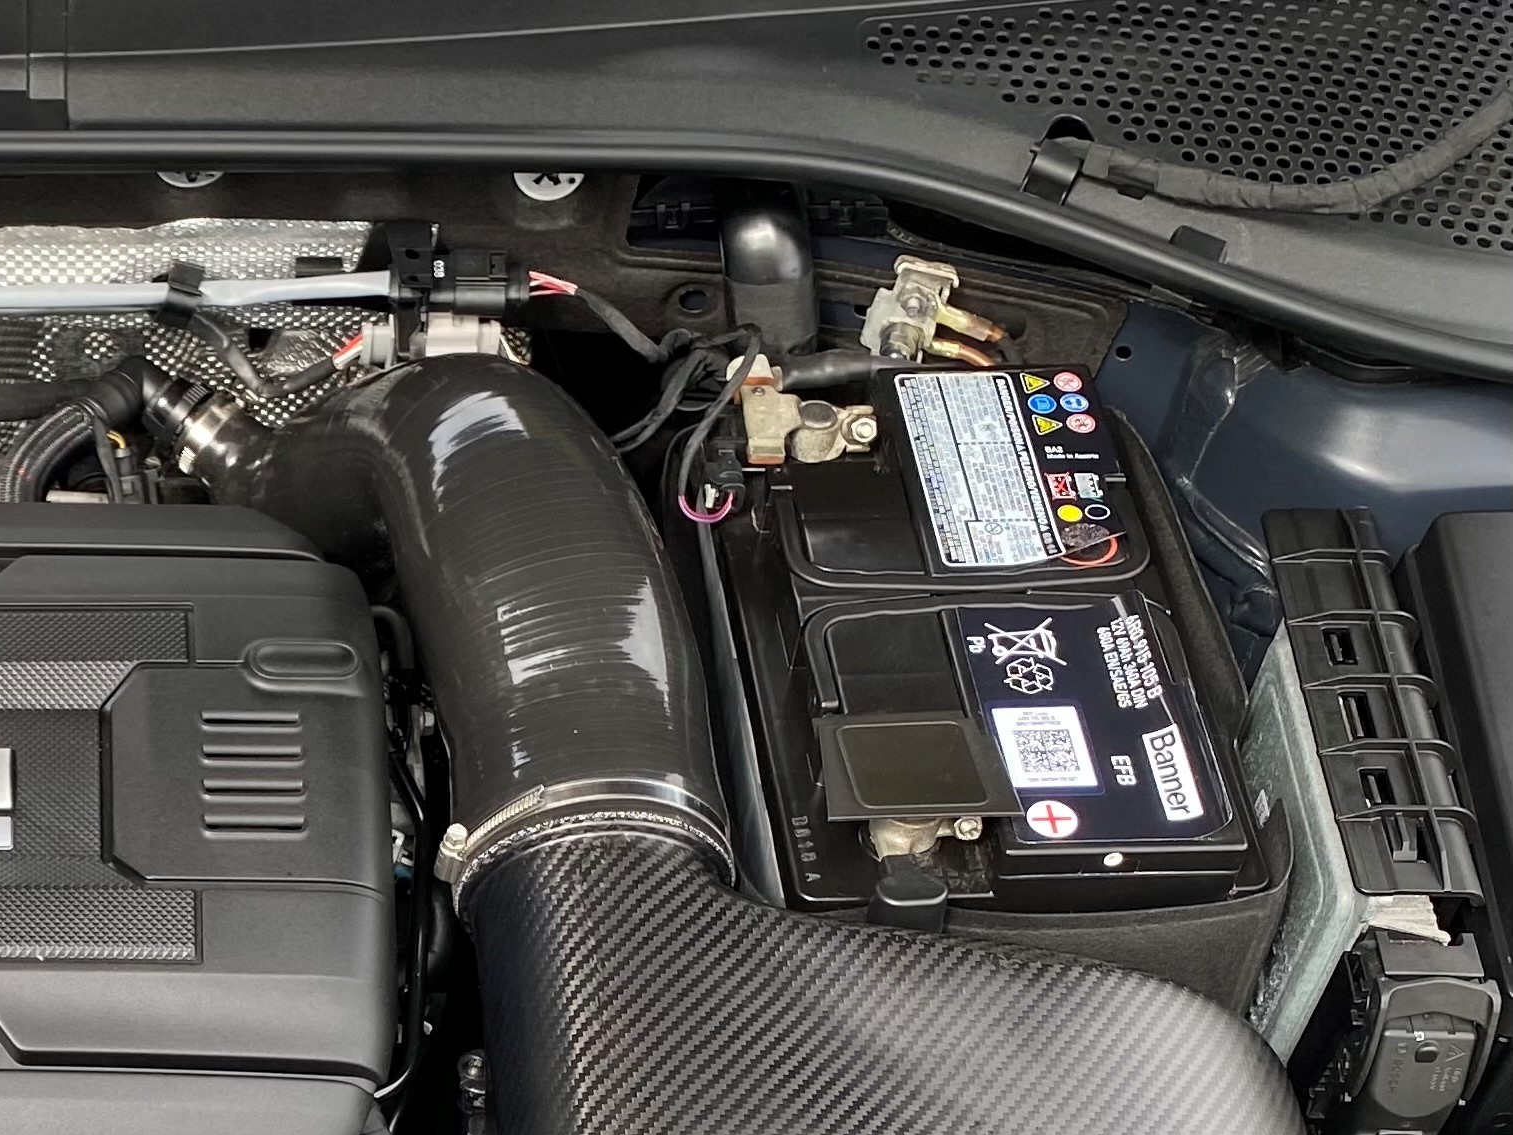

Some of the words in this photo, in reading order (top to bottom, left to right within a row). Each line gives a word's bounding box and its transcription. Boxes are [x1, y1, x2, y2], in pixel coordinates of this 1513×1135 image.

[966, 636, 986, 654] Pb
[1132, 638, 1152, 663] 915
[1110, 617, 1127, 636] 12V
[1130, 687, 1149, 709] DIN
[1140, 661, 1159, 687] 105
[1147, 684, 1163, 699] B
[1111, 755, 1137, 785] EFB
[1149, 729, 1190, 814] Banner
